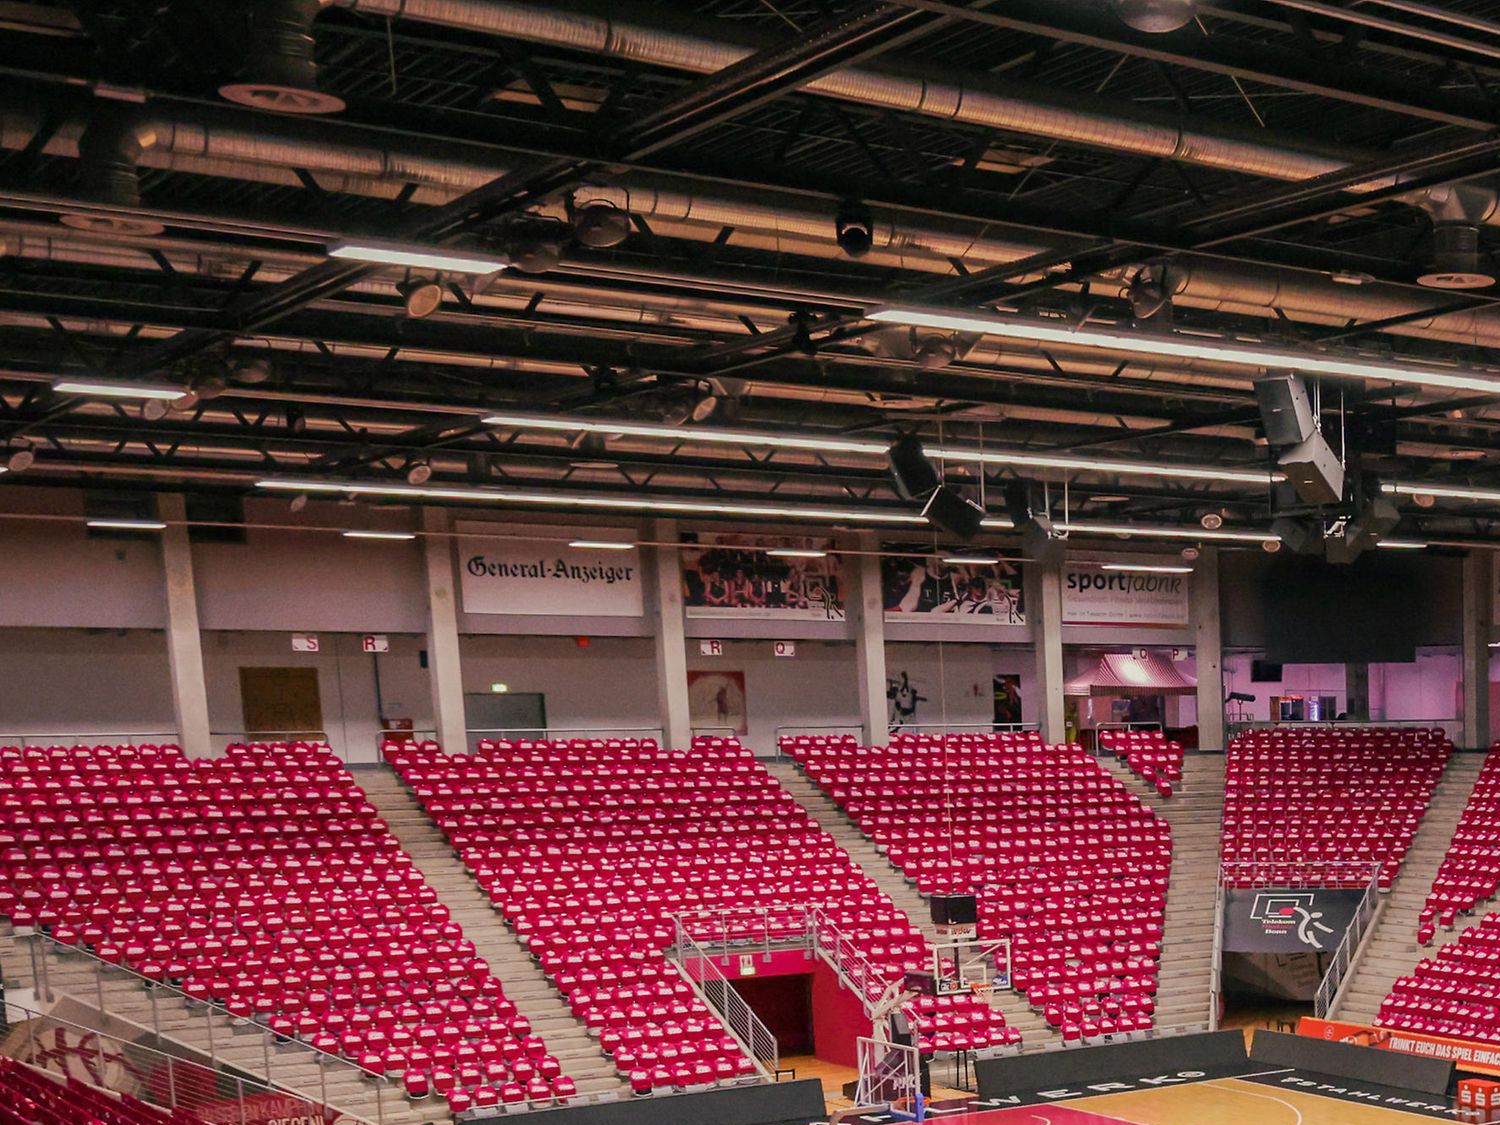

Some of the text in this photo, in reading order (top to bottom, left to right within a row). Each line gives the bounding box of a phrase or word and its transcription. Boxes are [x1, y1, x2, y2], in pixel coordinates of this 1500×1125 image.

[467, 555, 634, 584] General-Anzeiger
[306, 637, 317, 650] S
[364, 636, 377, 650] R
[709, 640, 721, 654] R
[775, 642, 786, 655] Q
[1388, 1037, 1415, 1052] TRINKT
[1415, 1041, 1436, 1055] EUCH
[1436, 1044, 1452, 1058] DAS
[1451, 1047, 1473, 1062] SPIEL
[1296, 1077, 1467, 1116] STAHLWERK
